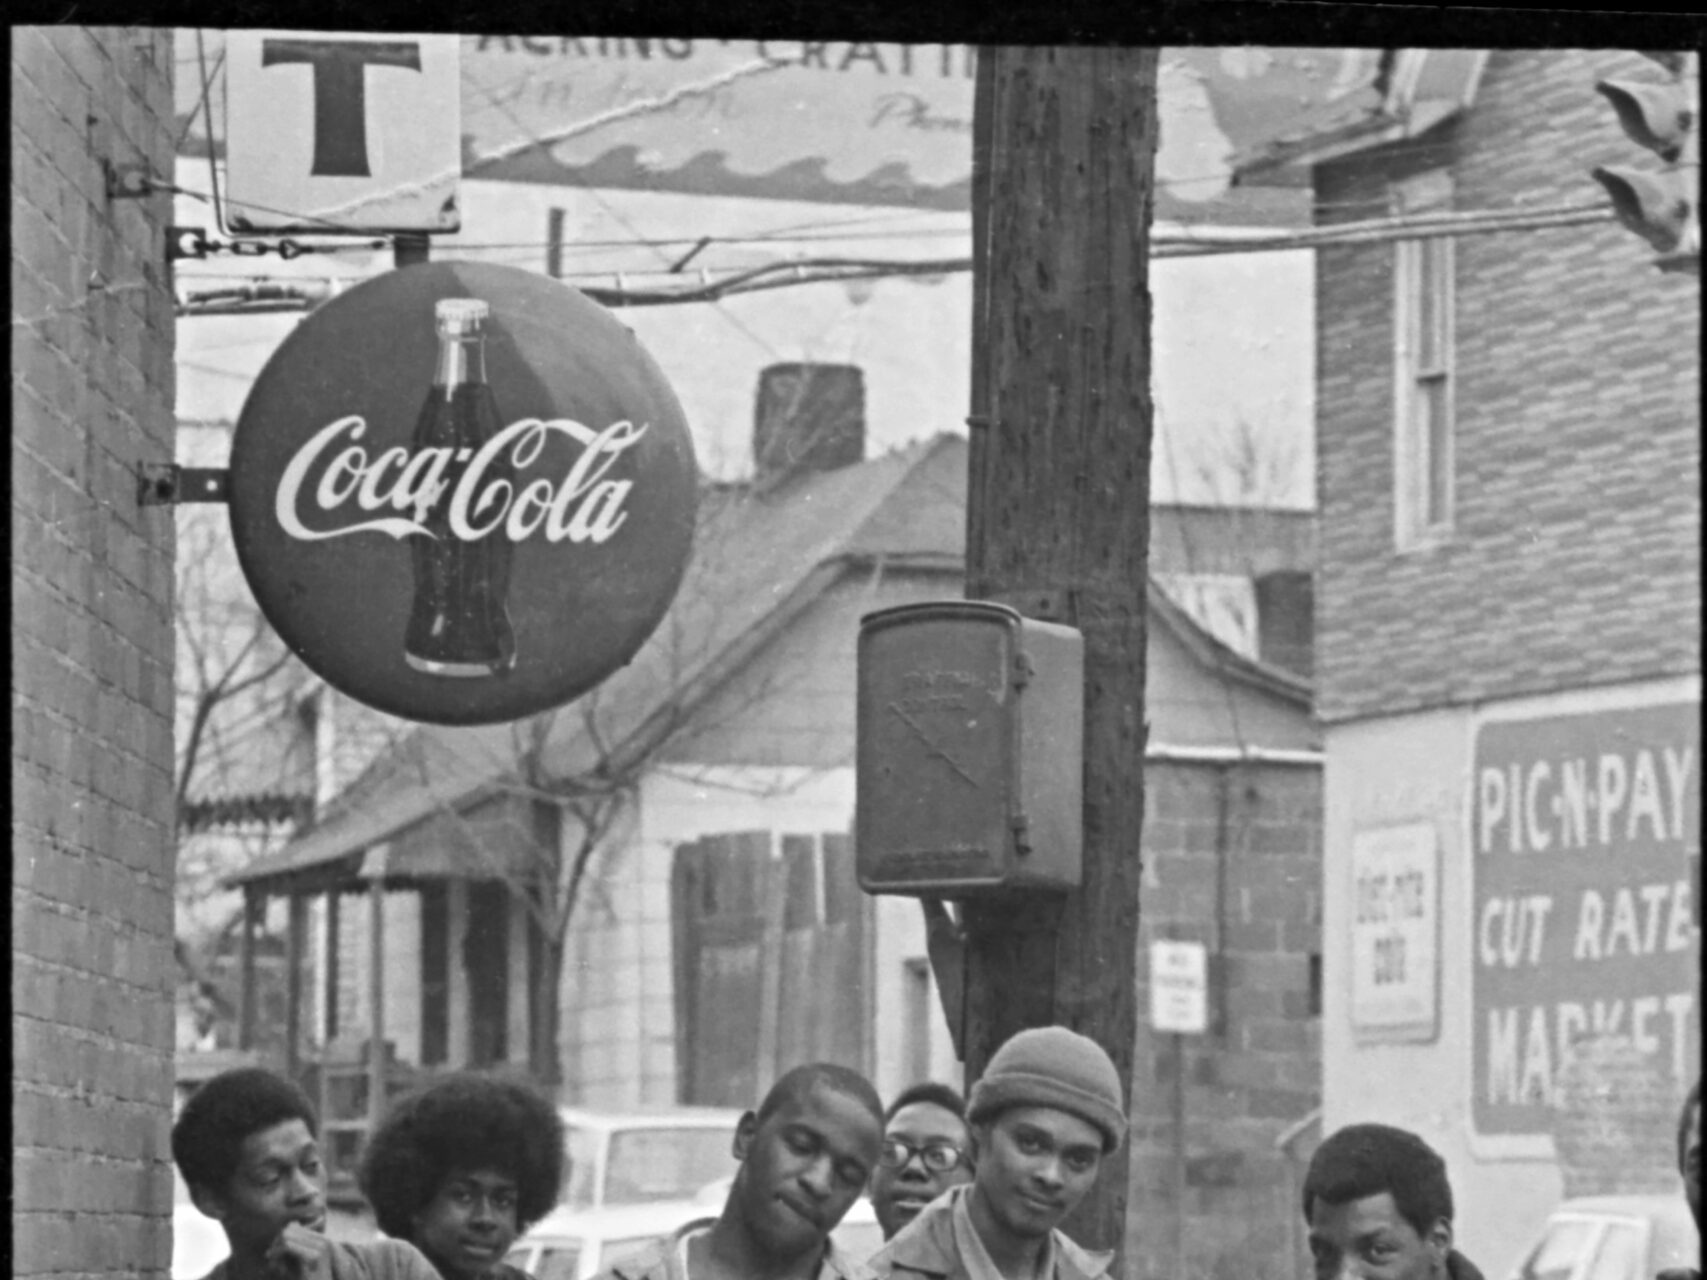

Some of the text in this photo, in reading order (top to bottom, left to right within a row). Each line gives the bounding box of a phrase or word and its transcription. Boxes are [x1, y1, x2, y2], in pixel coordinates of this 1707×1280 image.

[262, 38, 421, 177] T
[276, 414, 649, 543] Coca-Cola
[1480, 895, 1553, 968] CUT
[1573, 880, 1697, 961] RATE
